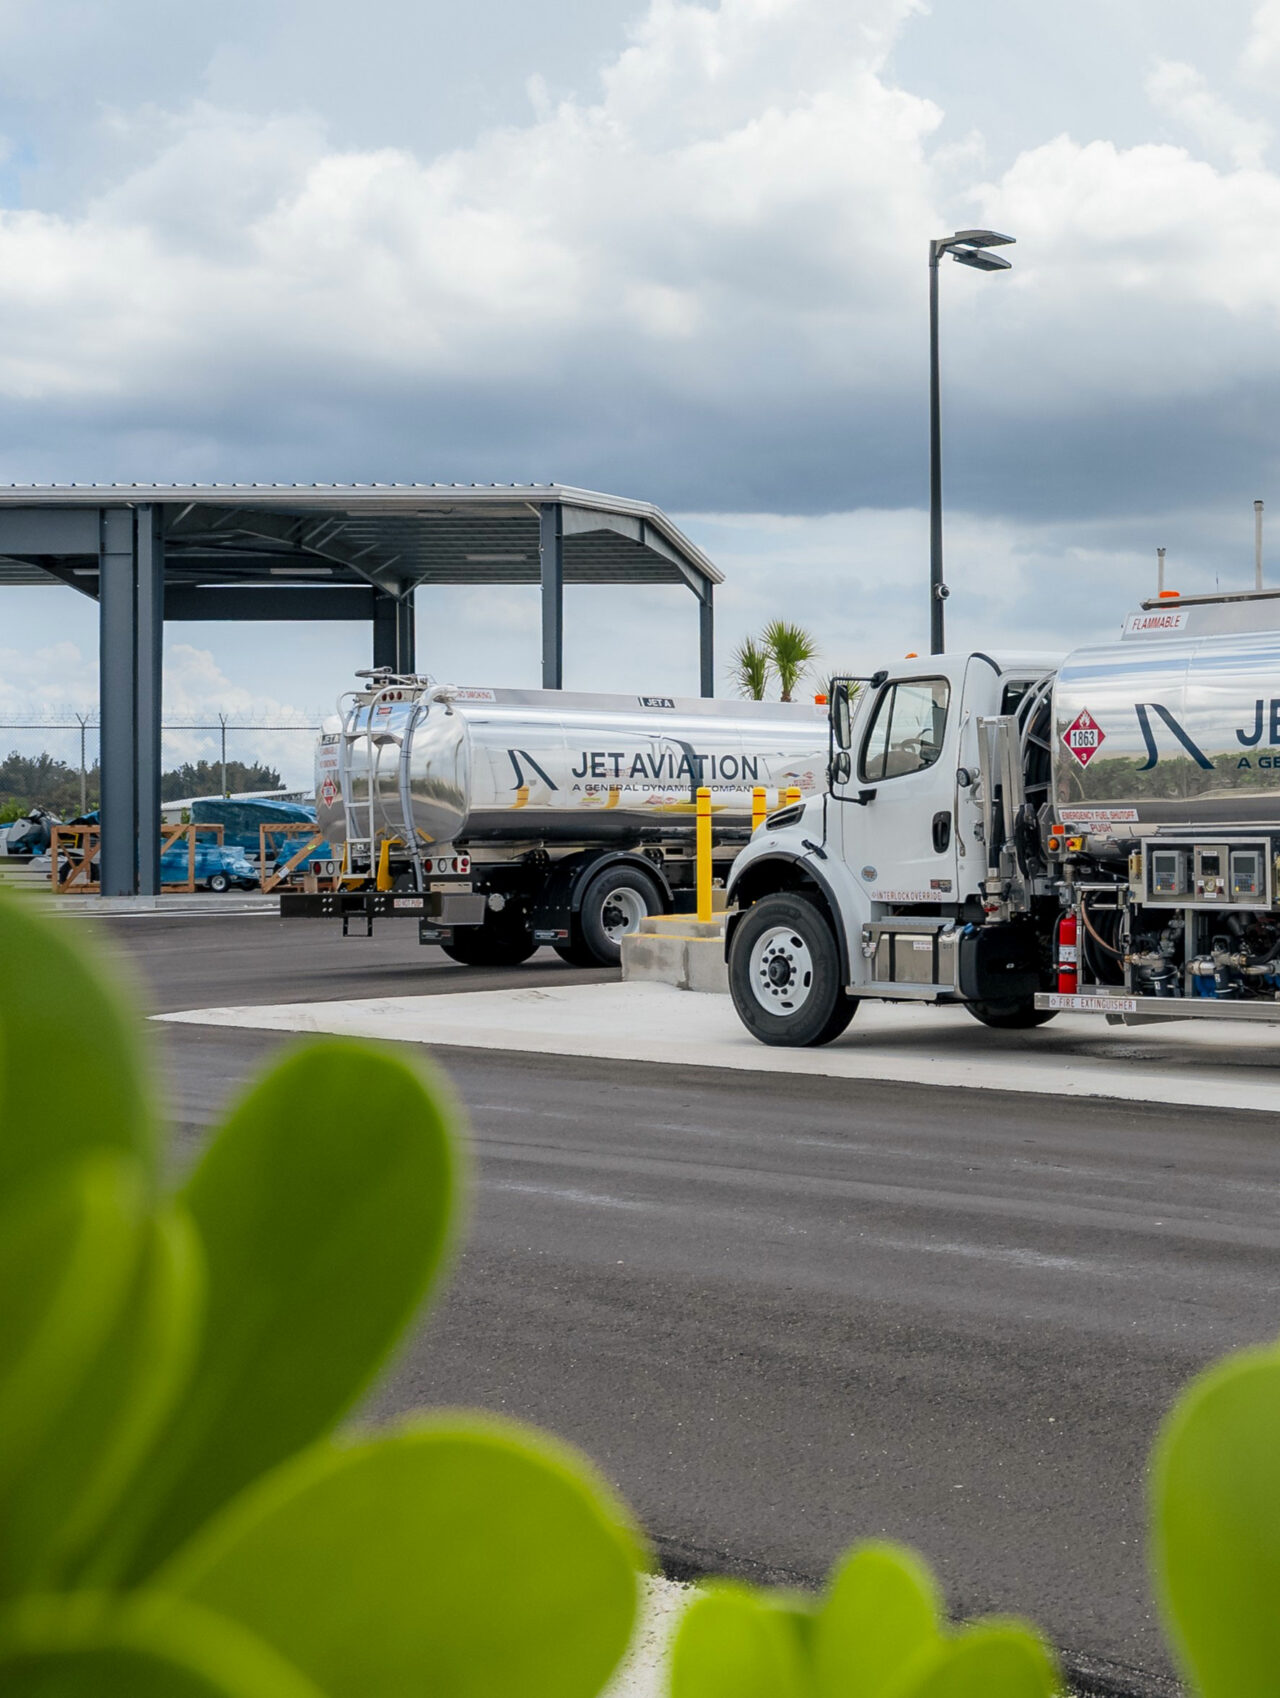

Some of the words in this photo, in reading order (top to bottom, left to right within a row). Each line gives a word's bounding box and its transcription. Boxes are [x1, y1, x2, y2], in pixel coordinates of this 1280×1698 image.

[1132, 615, 1181, 630] FLAMMABLE
[647, 698, 662, 706] JET
[664, 699, 672, 707] A
[1072, 730, 1095, 747] 1863
[1081, 753, 1087, 761] 3
[571, 751, 625, 778] JET
[629, 753, 759, 780] AVIATION
[1237, 756, 1252, 770] A
[572, 783, 582, 791] A
[584, 783, 639, 792] GENERAL
[1061, 811, 1094, 820] EMERGENCY
[1095, 811, 1110, 820] FUEL
[1109, 810, 1135, 820] SHUTOFF
[1090, 823, 1113, 833] PUSH
[1059, 998, 1075, 1008] FIRE
[1080, 998, 1134, 1010] EXTINGUISHER
